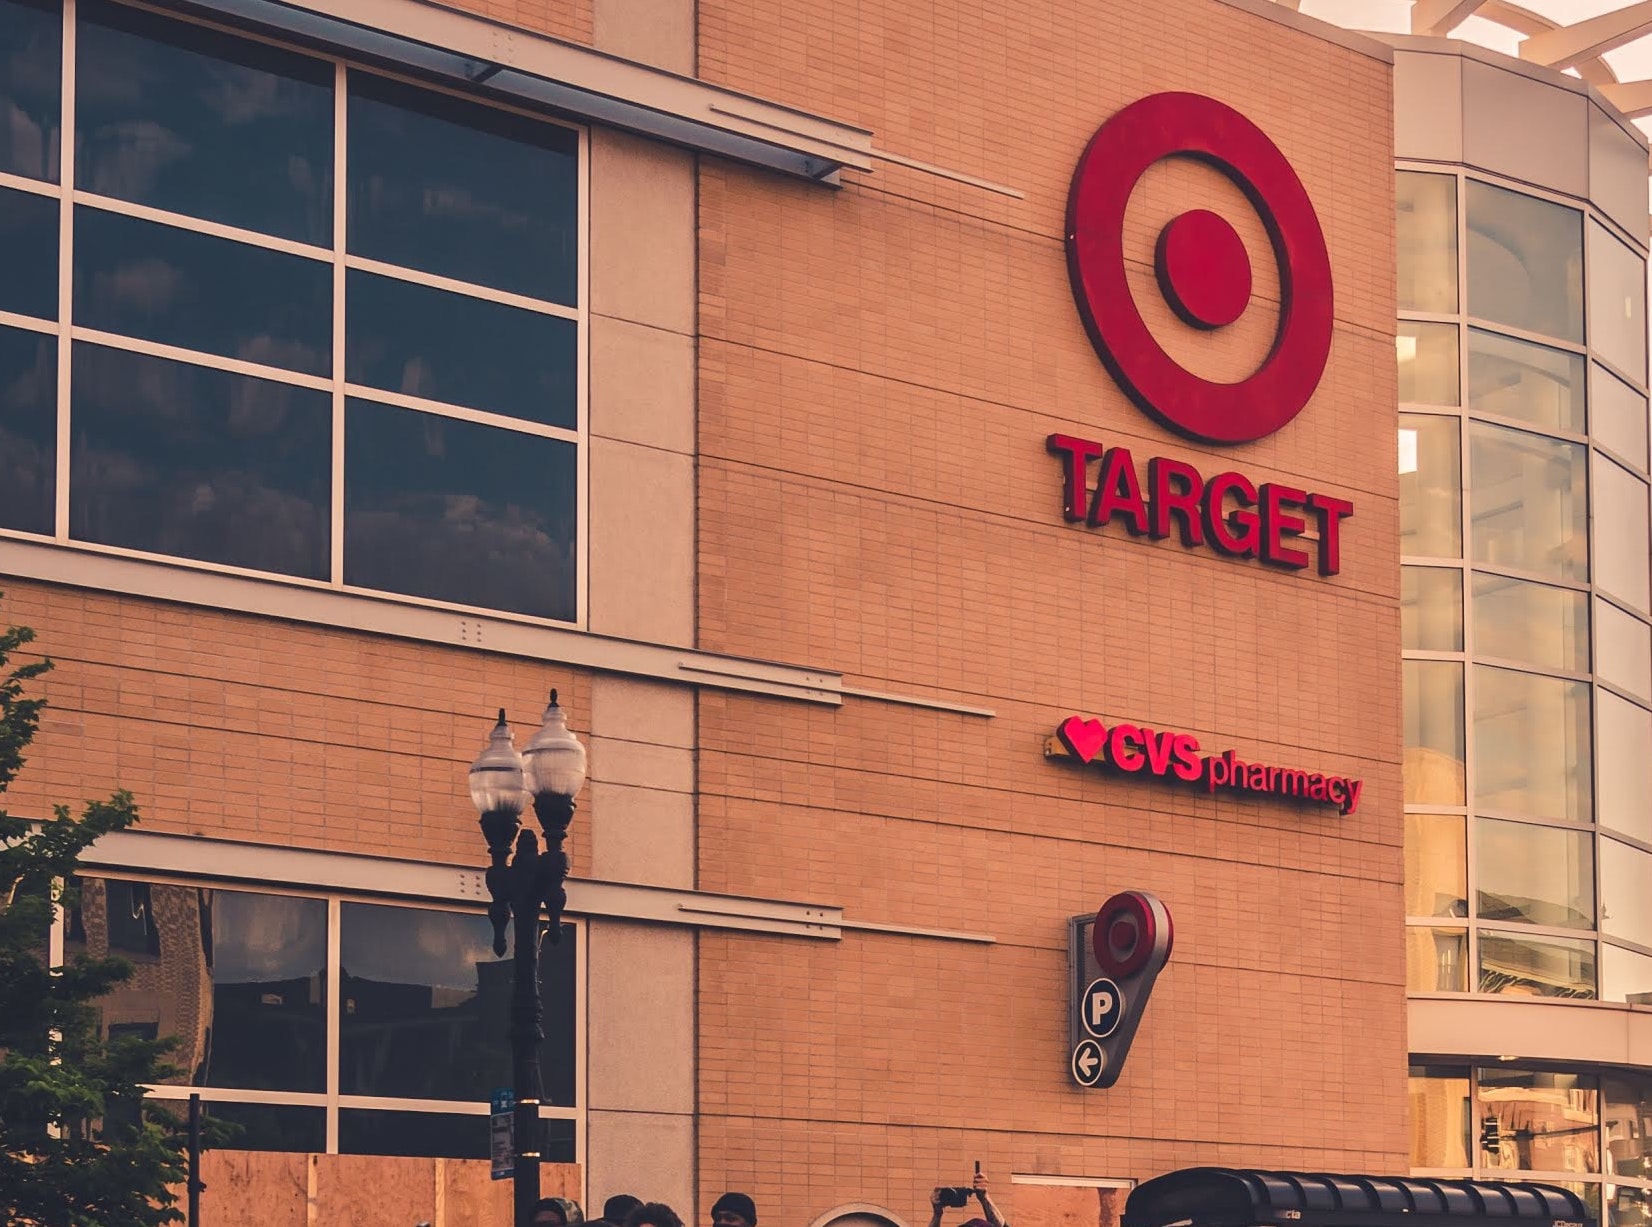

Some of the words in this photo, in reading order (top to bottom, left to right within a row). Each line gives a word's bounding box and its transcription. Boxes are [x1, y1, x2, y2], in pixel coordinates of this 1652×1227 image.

[1047, 433, 1353, 576] TARGET
[1108, 724, 1203, 781] CVS
[1207, 750, 1363, 815] pharmacy
[1092, 992, 1113, 1025] P
